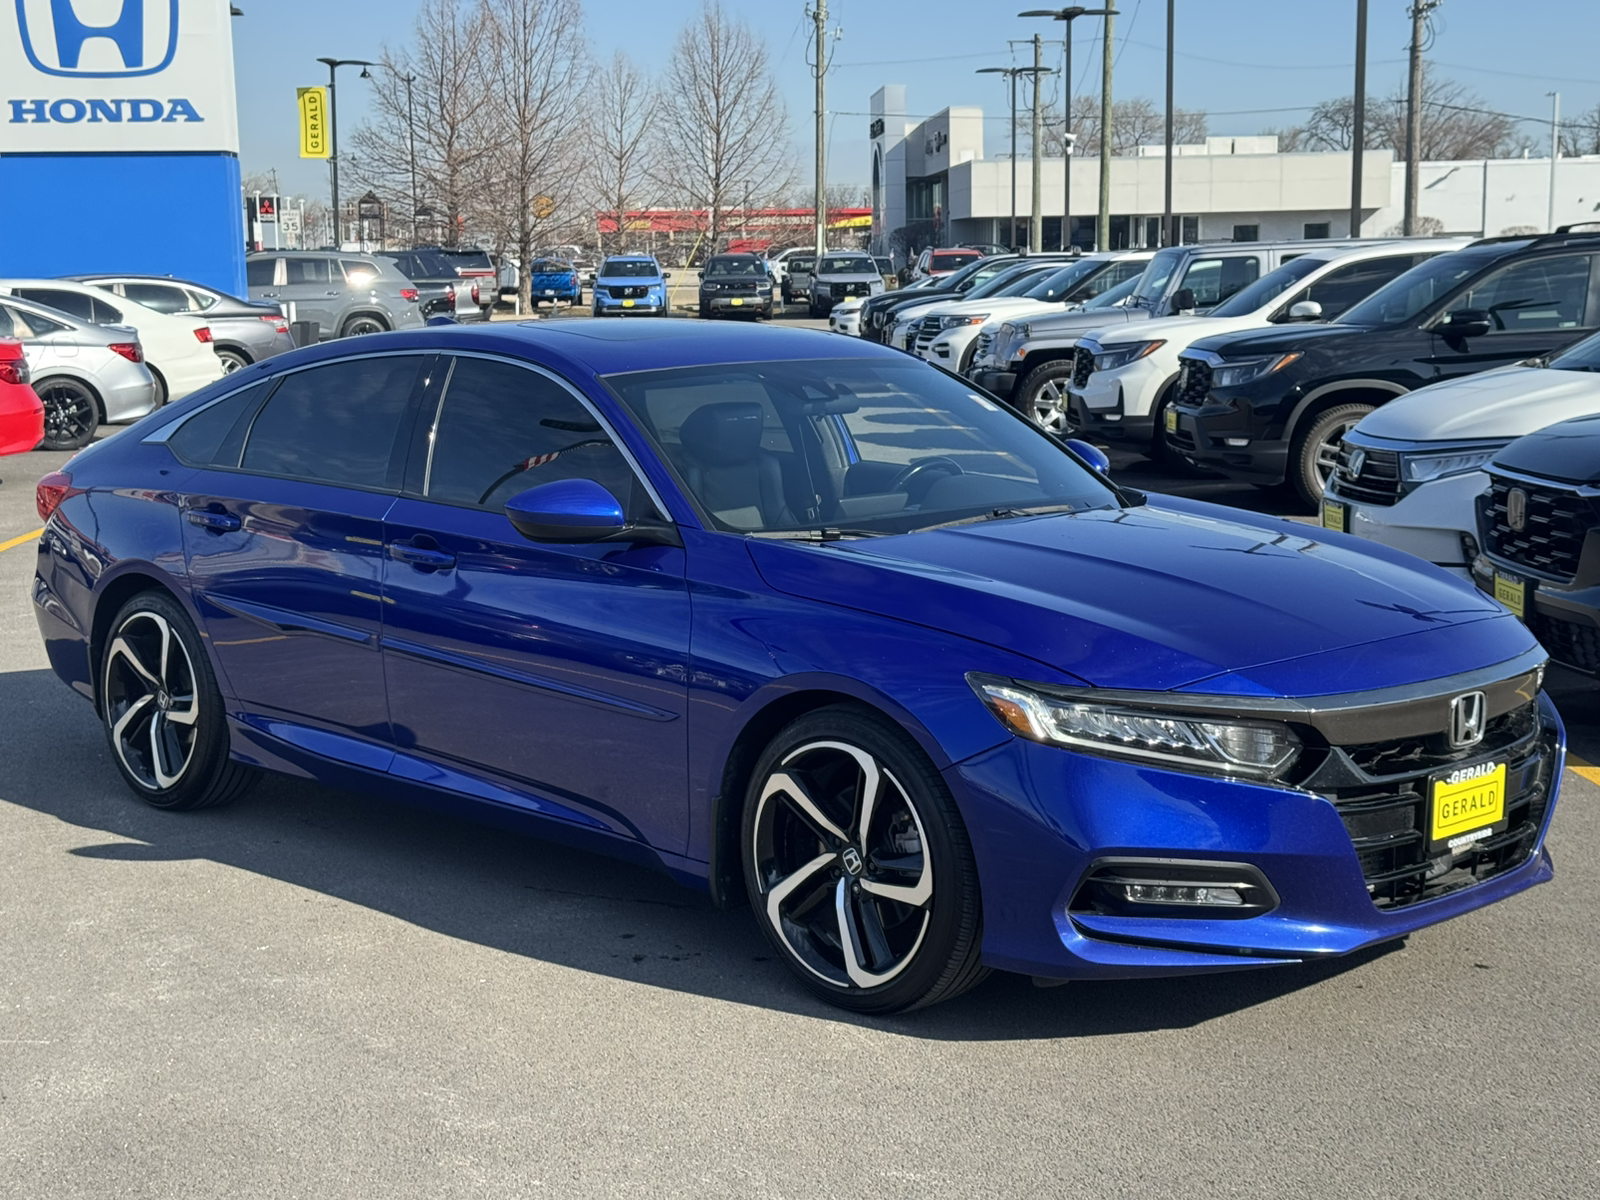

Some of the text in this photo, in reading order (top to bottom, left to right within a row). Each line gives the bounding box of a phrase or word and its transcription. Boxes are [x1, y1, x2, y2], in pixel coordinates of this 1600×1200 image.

[8, 98, 205, 124] HONDA
[308, 96, 320, 149] GERALD
[283, 222, 299, 231] 35
[1498, 587, 1522, 606] GERALD
[1450, 761, 1496, 784] GERALD
[1442, 790, 1496, 819] GERALD
